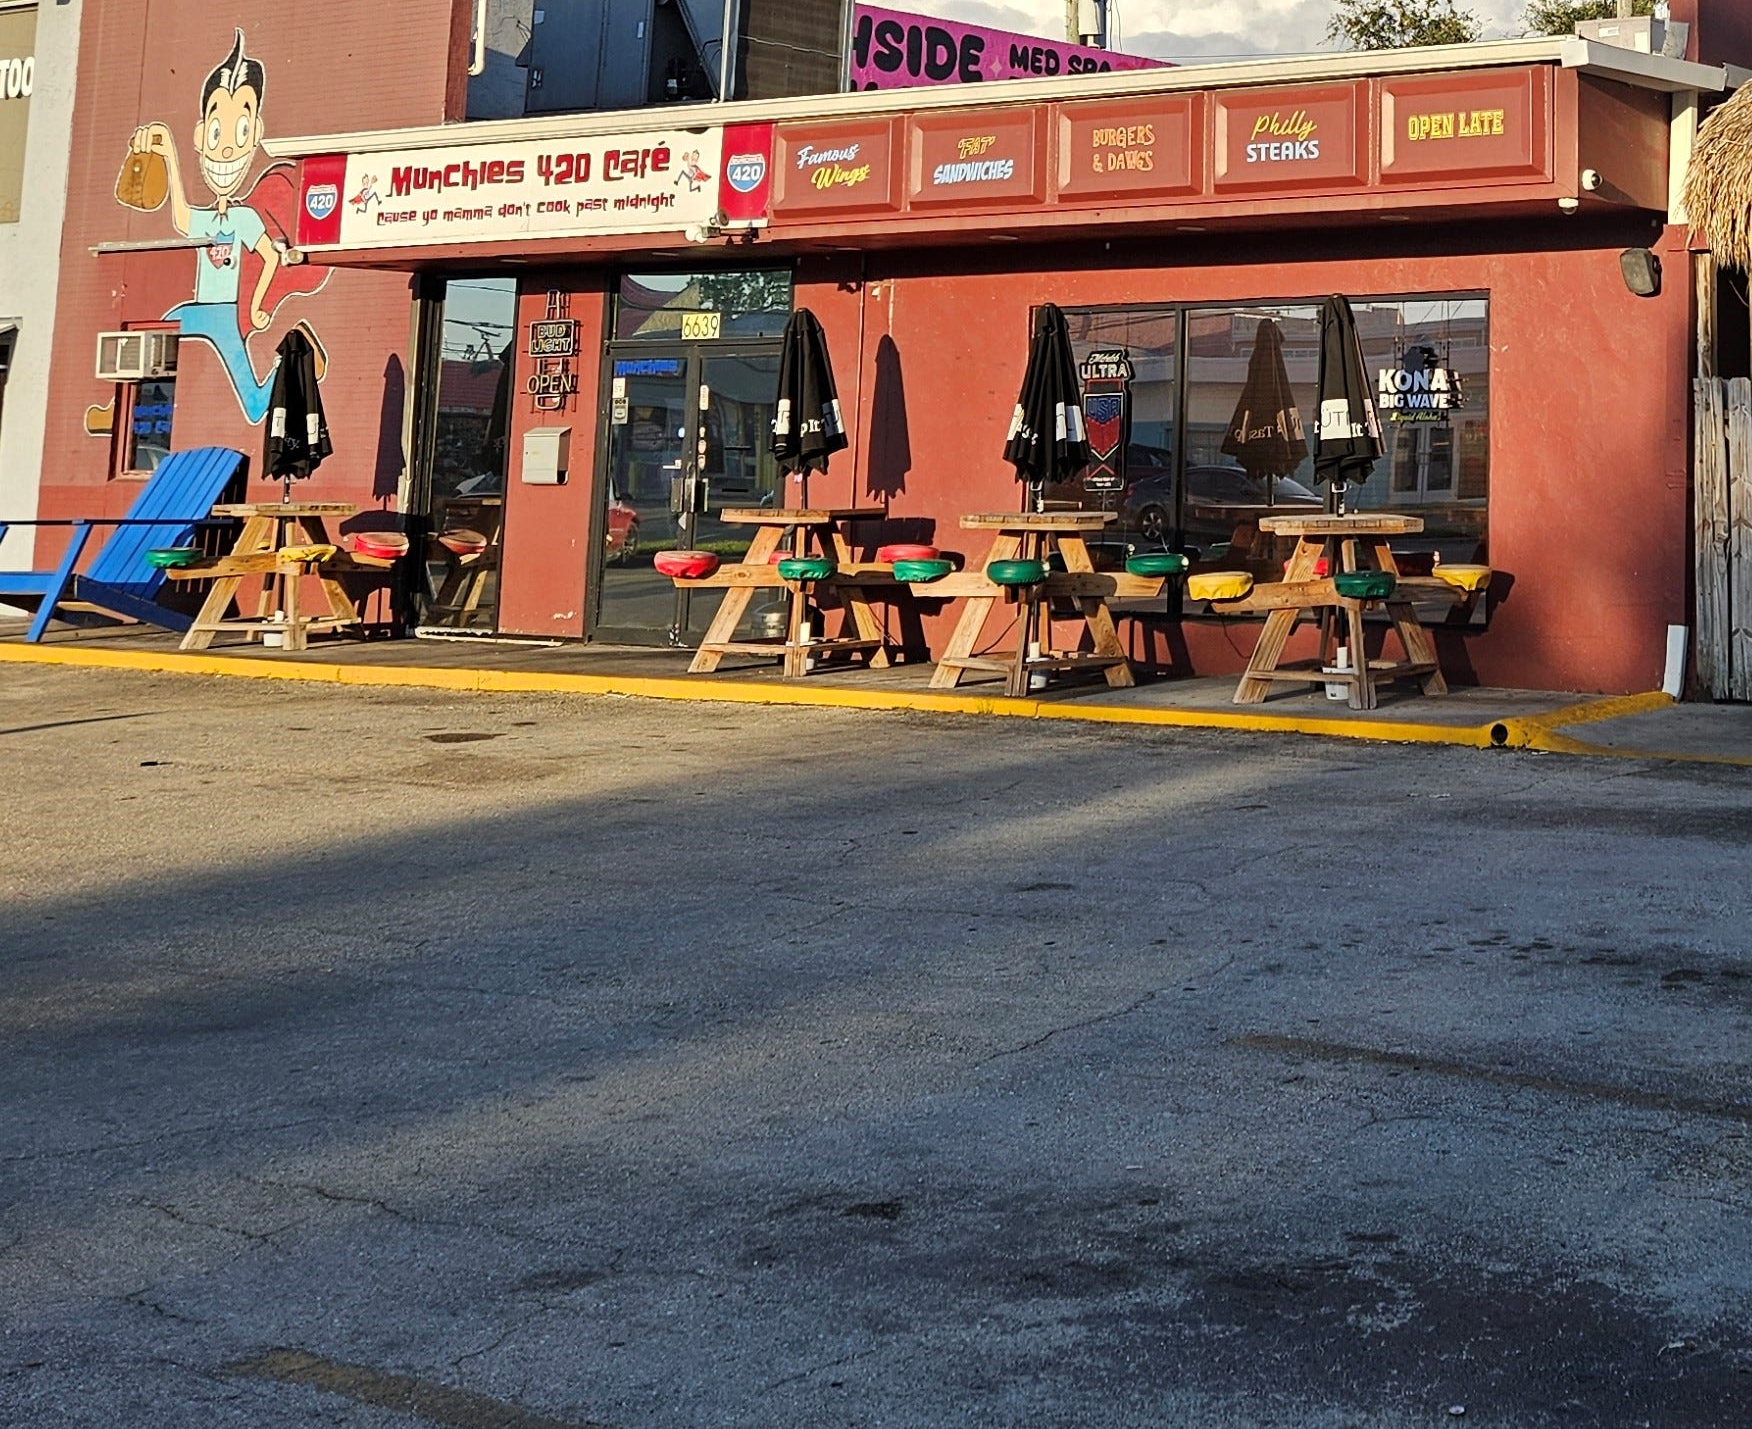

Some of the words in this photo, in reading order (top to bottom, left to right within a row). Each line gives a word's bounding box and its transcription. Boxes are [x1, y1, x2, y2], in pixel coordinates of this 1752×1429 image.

[1009, 43, 1060, 76] MED
[1092, 124, 1156, 148] BURGERS
[1250, 109, 1318, 141] Philly
[1408, 112, 1454, 141] OPEN
[1458, 108, 1504, 137] LATE
[796, 143, 860, 170] Famous
[1092, 153, 1103, 173] &
[1107, 150, 1154, 172] DAWGS
[1246, 140, 1320, 163] STEAKS
[386, 160, 525, 197] Munchies
[537, 152, 591, 186] 420
[603, 140, 670, 182] Café
[731, 164, 761, 181] 420
[811, 163, 871, 190] Wings
[933, 159, 1014, 185] SANDWICHES
[310, 194, 334, 210] 420
[421, 209, 438, 226] yo
[443, 207, 493, 222] mamma
[498, 201, 530, 218] don't
[537, 199, 571, 214] cook
[576, 198, 608, 217] past
[613, 192, 676, 214] midnight
[537, 324, 566, 338] BUD
[684, 315, 718, 338] 6639
[531, 338, 570, 352] LIGHT
[1081, 363, 1127, 379] ULTRA
[1379, 368, 1448, 392] KONA
[527, 375, 572, 394] OPEN
[1087, 398, 1120, 422] USA
[1379, 393, 1404, 409] BIG
[1407, 393, 1449, 409] WAVE
